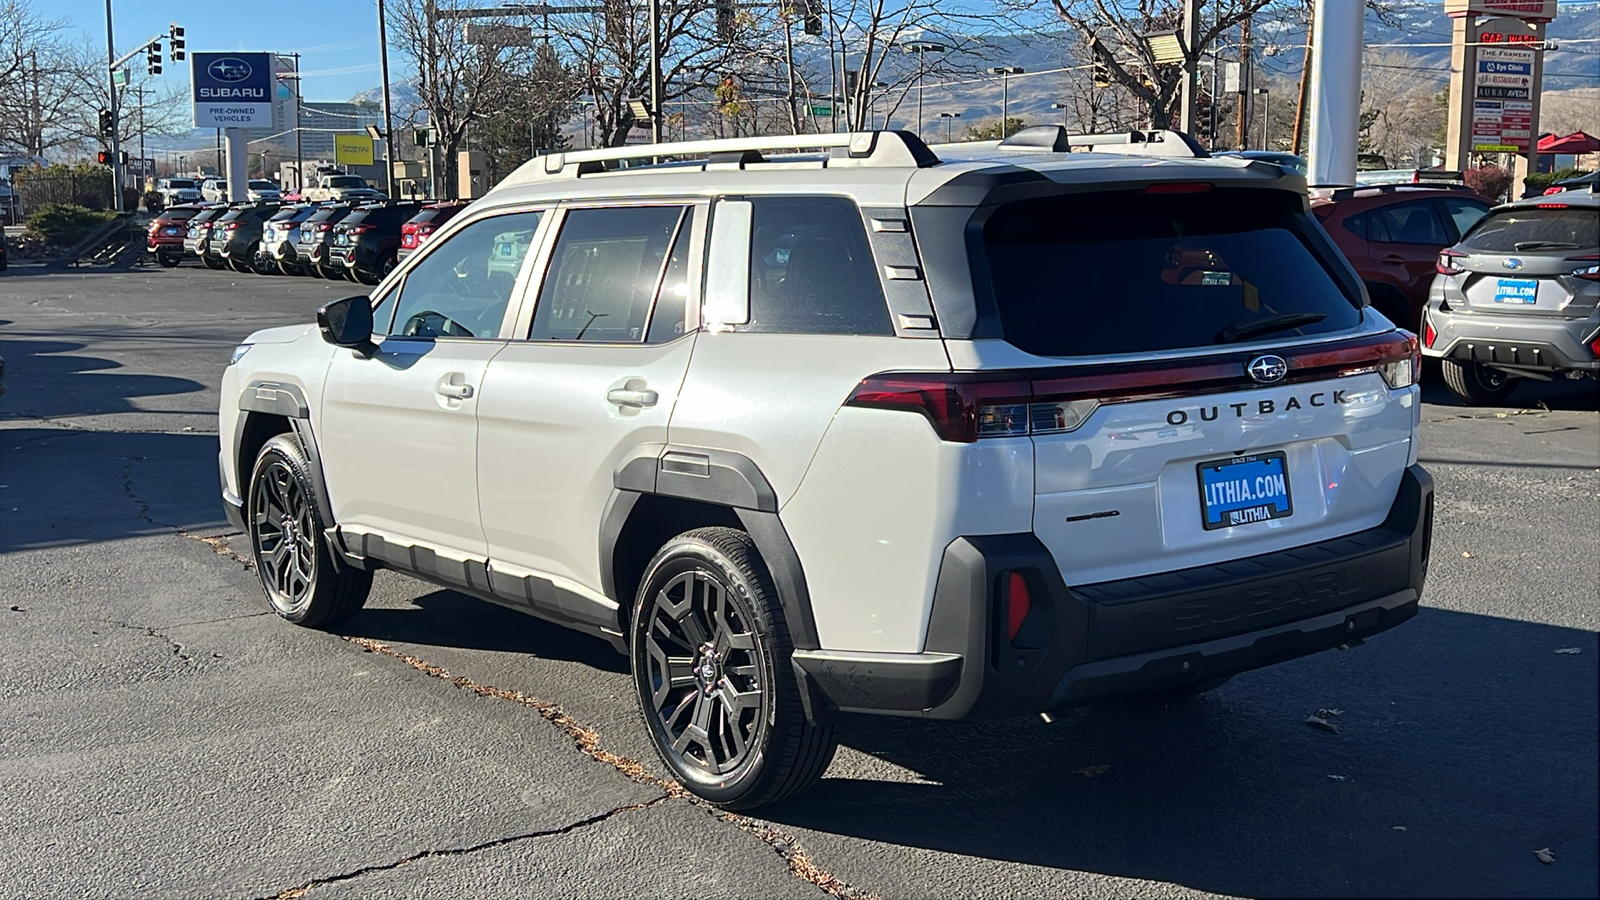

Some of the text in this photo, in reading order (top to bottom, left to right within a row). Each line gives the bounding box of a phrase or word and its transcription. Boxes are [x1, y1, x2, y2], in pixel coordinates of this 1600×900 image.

[1481, 32, 1538, 46] CAR WASH
[1496, 63, 1524, 72] Eye Clinic
[1492, 76, 1521, 84] RESTAURANT
[200, 87, 264, 98] SUBARU
[1479, 88, 1528, 98] AURA AVEDA
[209, 107, 256, 115] PRE-OWNED
[1497, 286, 1536, 297] LITHIA.COM
[1166, 389, 1347, 425] OUTBACK
[1231, 457, 1246, 465] SINCE
[1204, 473, 1287, 507] LITHIA.COM
[1239, 505, 1271, 523] LITHIA
[1175, 564, 1366, 631] SUBARU
